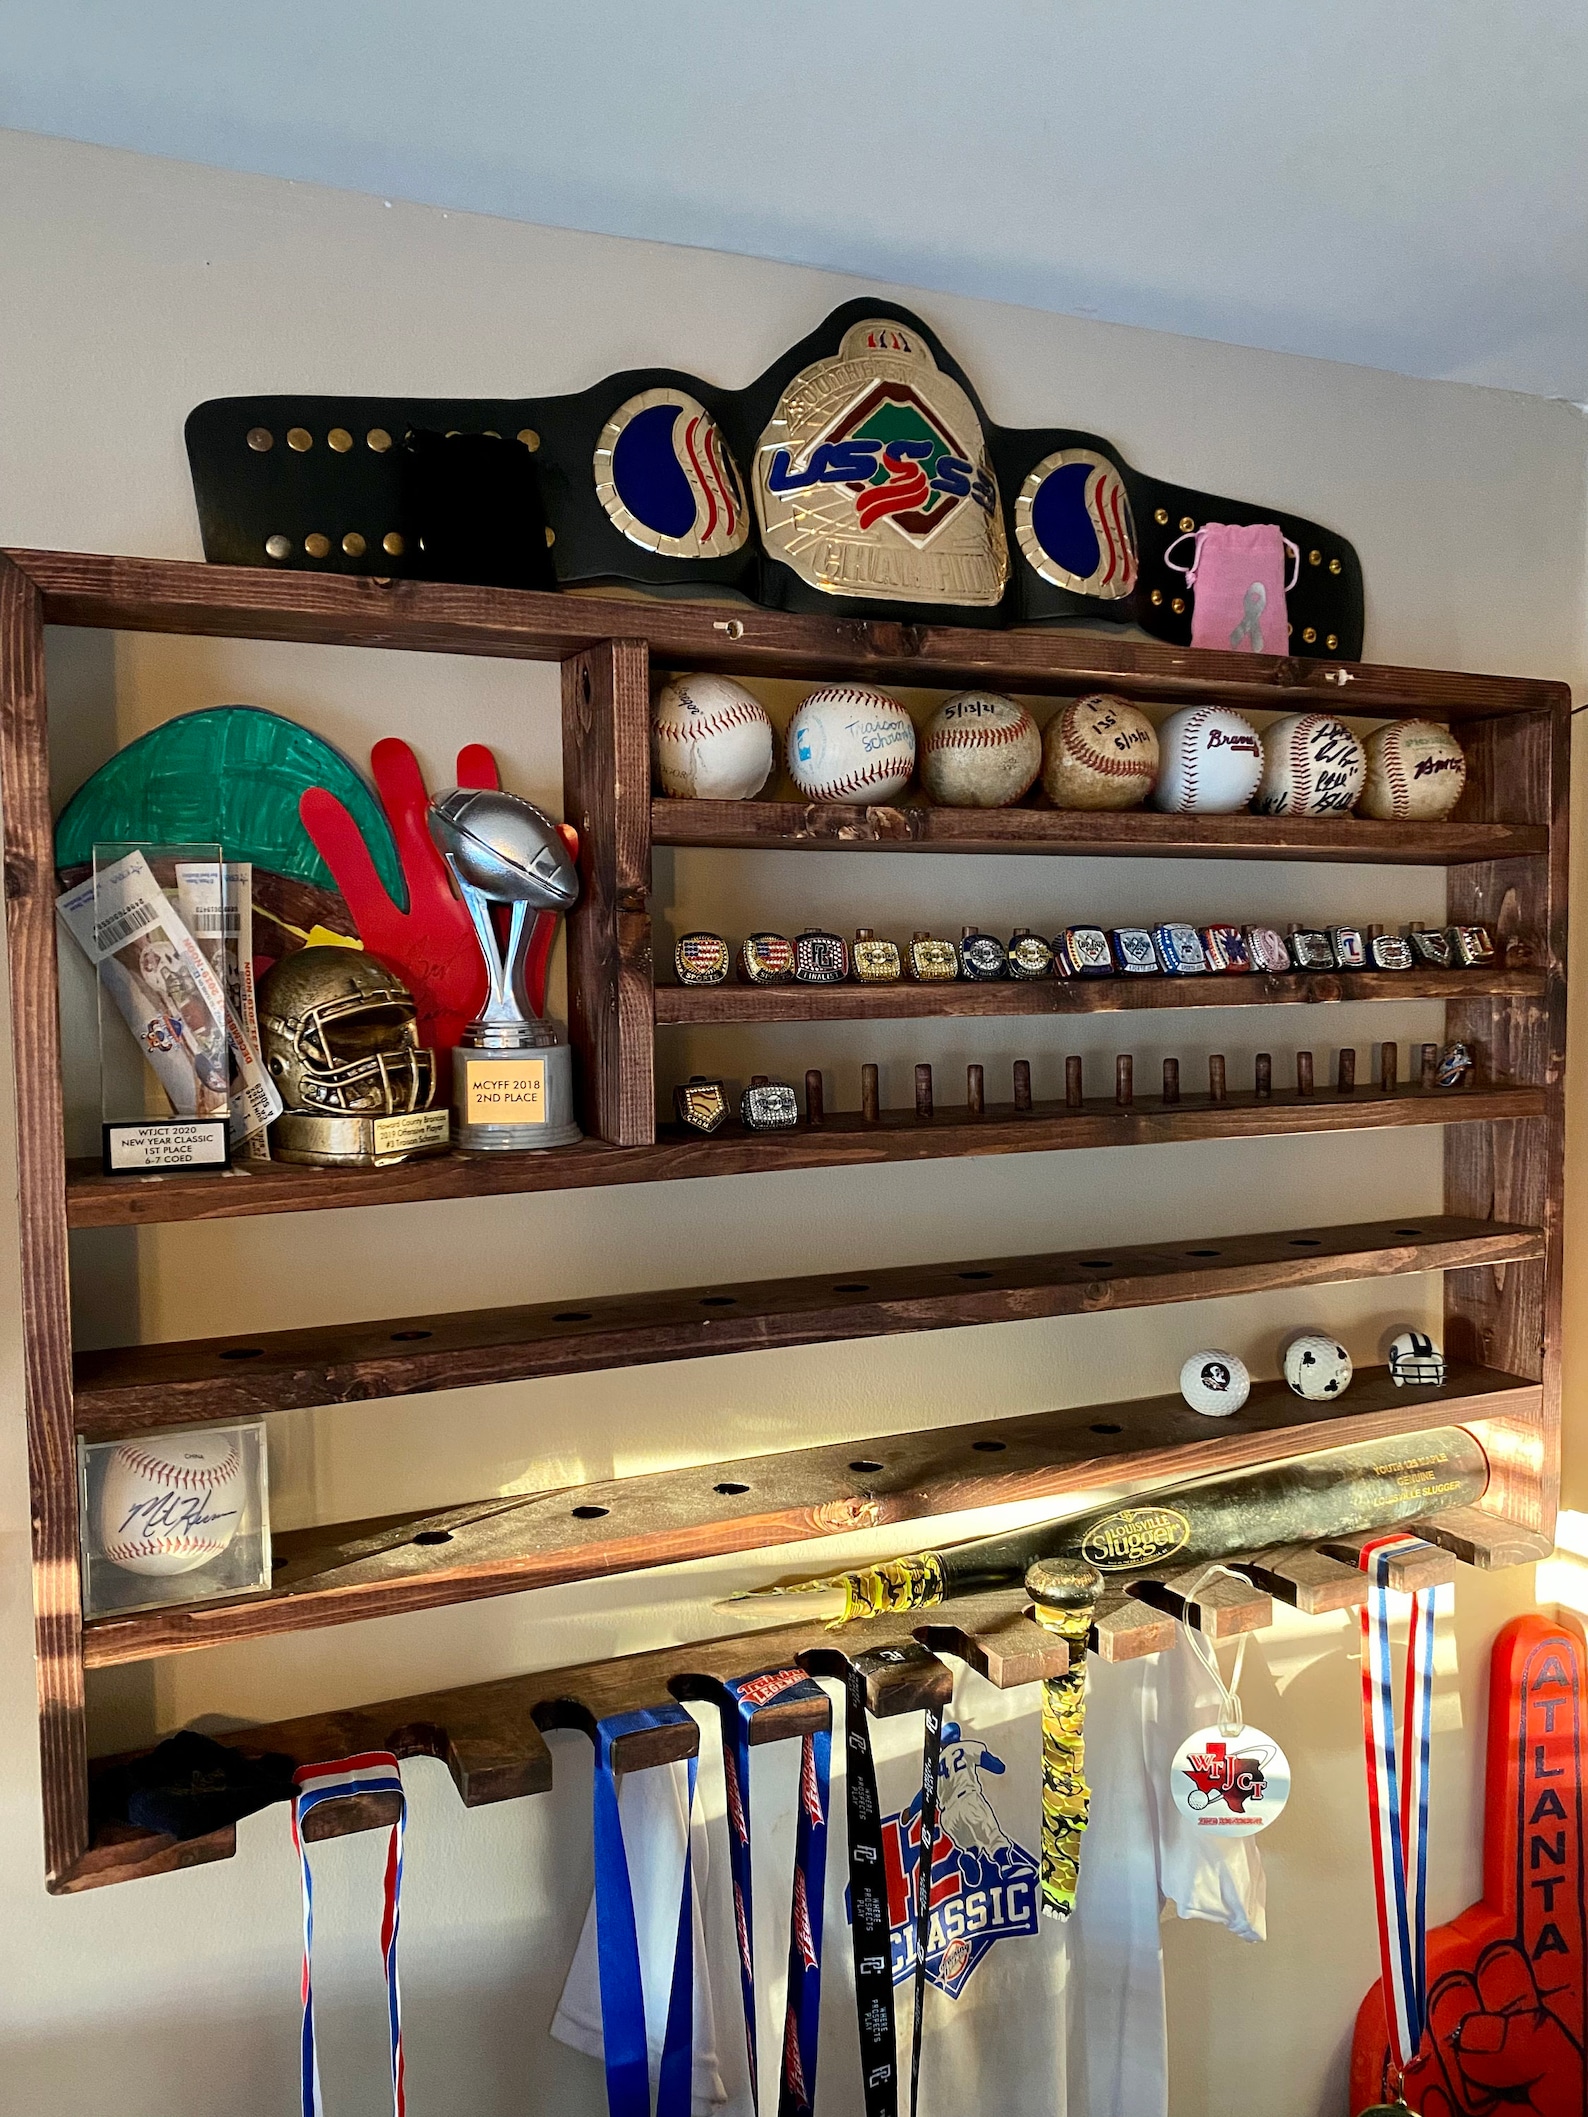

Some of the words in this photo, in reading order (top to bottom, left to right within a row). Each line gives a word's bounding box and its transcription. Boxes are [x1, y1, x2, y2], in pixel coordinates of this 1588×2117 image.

[945, 701, 995, 719] 5/13/21
[1114, 730, 1150, 751] 5/13/21
[183, 938, 203, 968] NOON
[244, 961, 252, 993] NOON
[225, 1009, 254, 1065] DECEMBE
[473, 1080, 510, 1090] MCYFF
[513, 1080, 540, 1090] 2018
[476, 1093, 501, 1103] 2ND
[504, 1093, 538, 1102] PLACE
[121, 1139, 145, 1147] NEW
[147, 1137, 171, 1145] YEAR
[174, 1134, 214, 1144] CLASSIC
[138, 1128, 170, 1137] WTJCT
[173, 1126, 197, 1134] 2020
[145, 1147, 160, 1155] 1ST
[163, 1145, 192, 1154] PLACE
[145, 1157, 161, 1165] 6-7
[164, 1155, 192, 1163] COED
[1396, 1471, 1436, 1486] GENUINE
[1422, 1480, 1461, 1497] SLUGGER
[1111, 1515, 1170, 1538] LOUISVILLE
[1092, 1524, 1176, 1560] Slugger
[1187, 1753, 1267, 1800] WTJCT
[851, 1785, 859, 1805] PLAY
[857, 1775, 866, 1820] PROSPECTS
[865, 1788, 873, 1814] WHERE
[1529, 1656, 1572, 1960] ATLANTA
[857, 1899, 865, 1918] PLAY
[864, 1887, 873, 1932] PROSPECTS
[872, 1897, 881, 1923] WHERE
[864, 2012, 872, 2031] PLAY
[871, 1998, 881, 2043] PROSPECTS
[879, 2006, 888, 2032] WHERE
